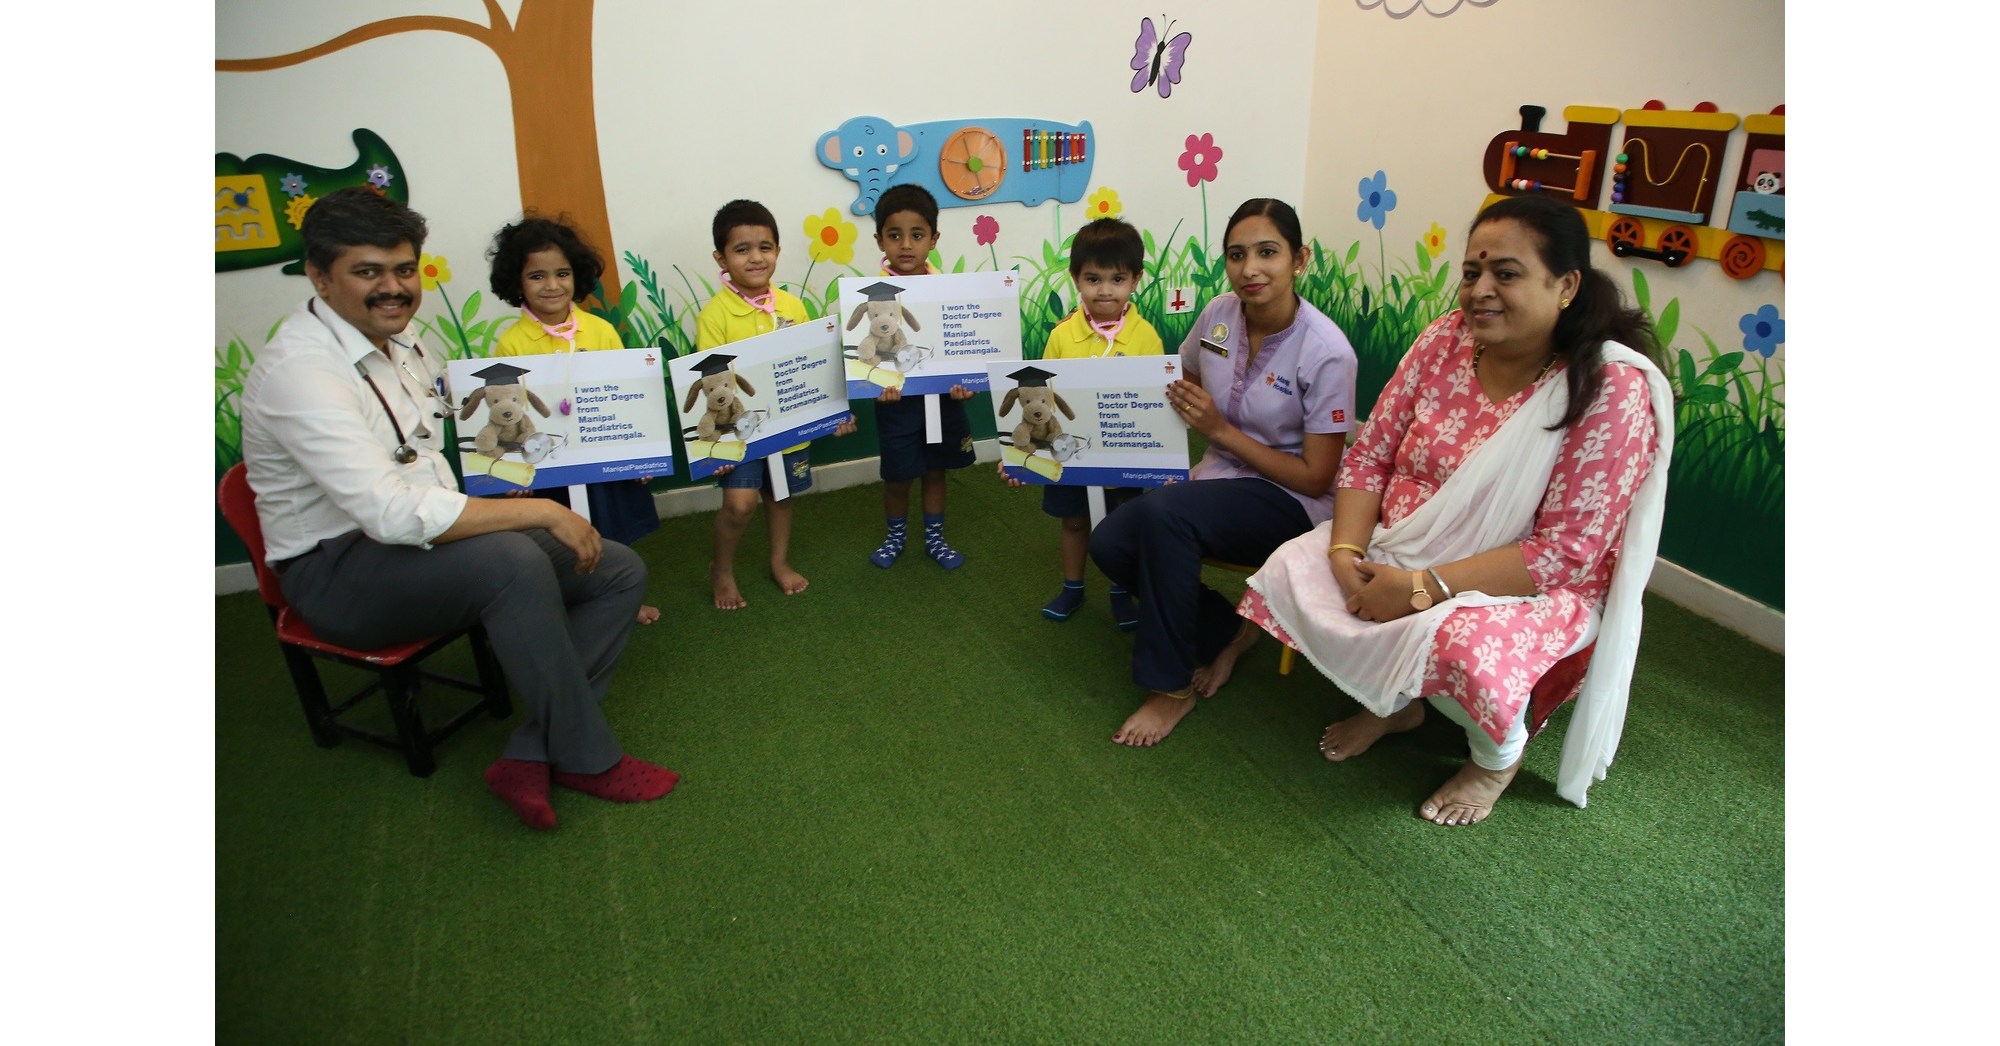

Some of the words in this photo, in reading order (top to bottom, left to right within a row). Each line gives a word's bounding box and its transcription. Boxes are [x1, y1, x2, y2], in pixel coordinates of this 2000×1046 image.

[973, 312, 1002, 320] Degree
[944, 330, 975, 338] Manipal
[945, 347, 1000, 356] Koramangala.
[774, 368, 799, 378] Doctor
[801, 358, 827, 370] Degree
[778, 360, 793, 368] won
[776, 378, 793, 387] from
[581, 385, 601, 393] won
[604, 384, 619, 392] the
[777, 382, 805, 396] Manipal
[611, 392, 644, 401] Degree
[778, 387, 819, 404] Paediatrics
[780, 394, 829, 413] Koramangala.
[1131, 401, 1163, 410] Degree
[577, 405, 599, 413] from
[578, 414, 615, 423] Manipal
[580, 422, 633, 433] Paediatrics
[1100, 421, 1135, 429] Manipal
[581, 432, 645, 442] Koramangala.
